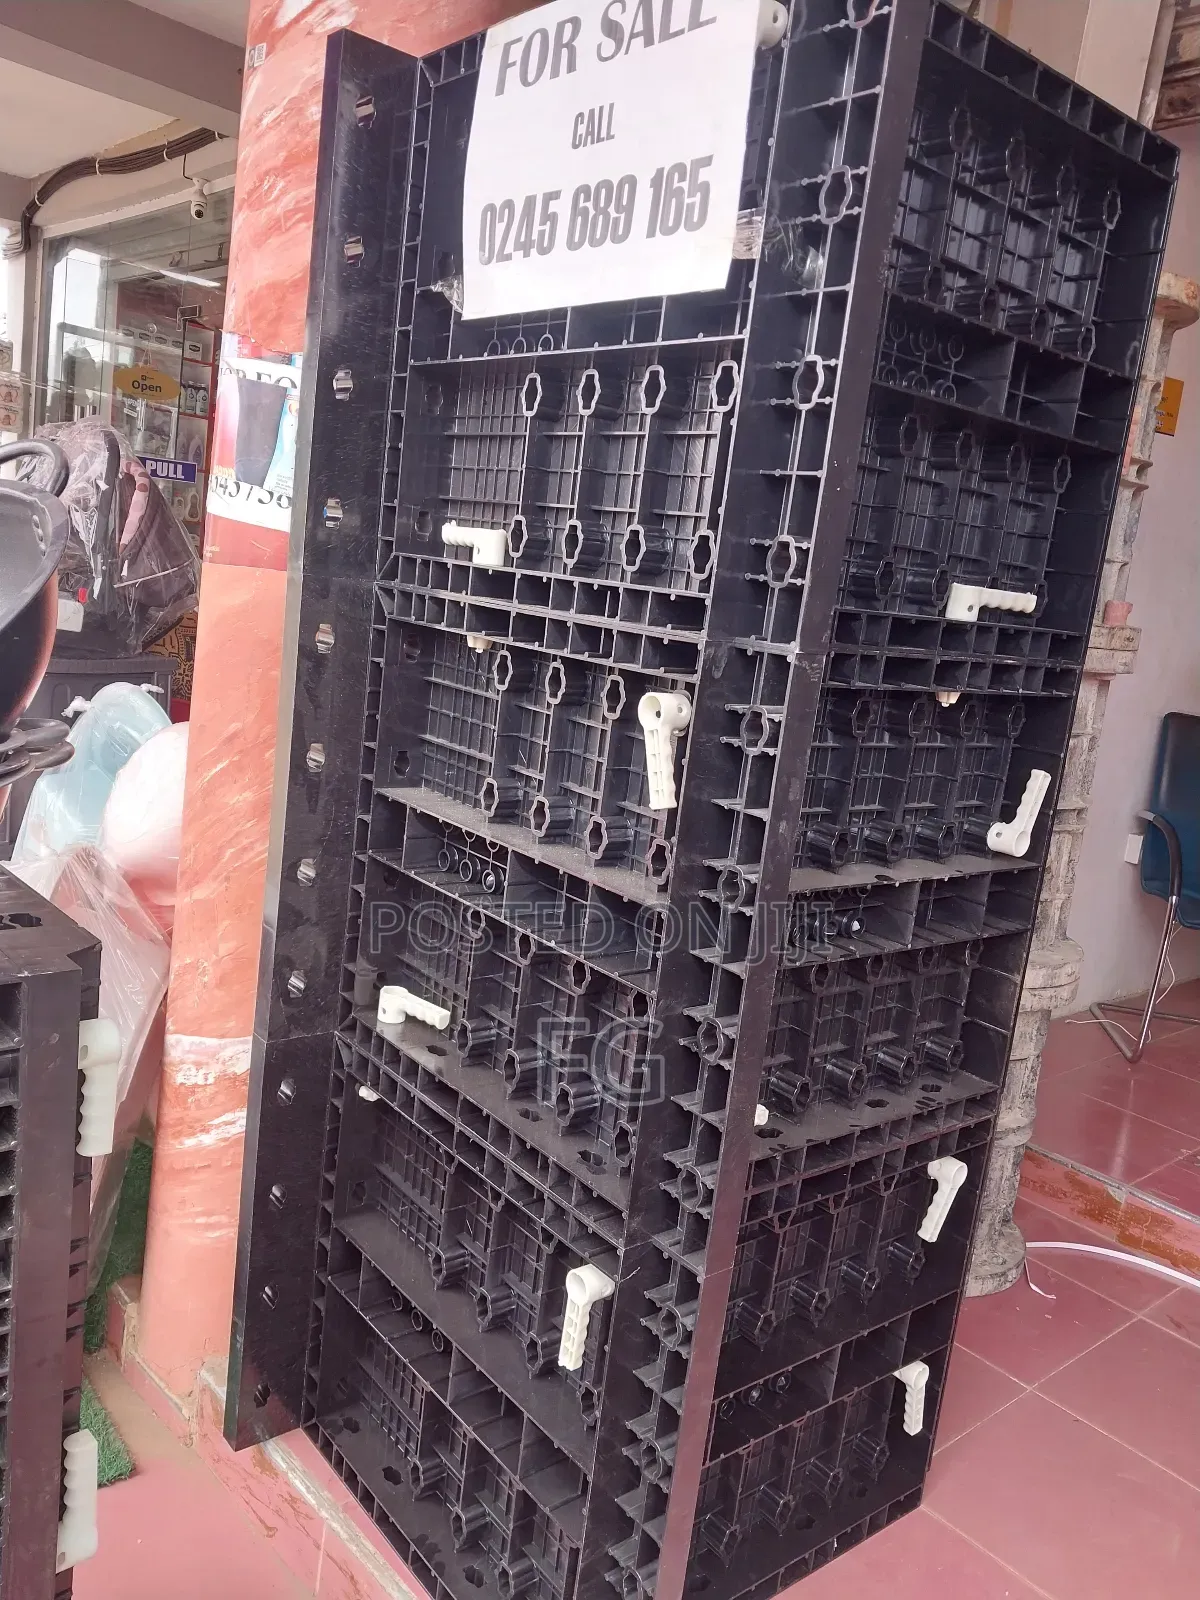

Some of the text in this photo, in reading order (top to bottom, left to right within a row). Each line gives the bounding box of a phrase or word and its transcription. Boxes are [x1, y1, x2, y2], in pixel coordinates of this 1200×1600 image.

[494, 15, 582, 97] FOR
[571, 102, 616, 150] CALL
[478, 154, 714, 266] 0245 689 165
[131, 379, 162, 393] Open
[145, 460, 185, 479] PULL
